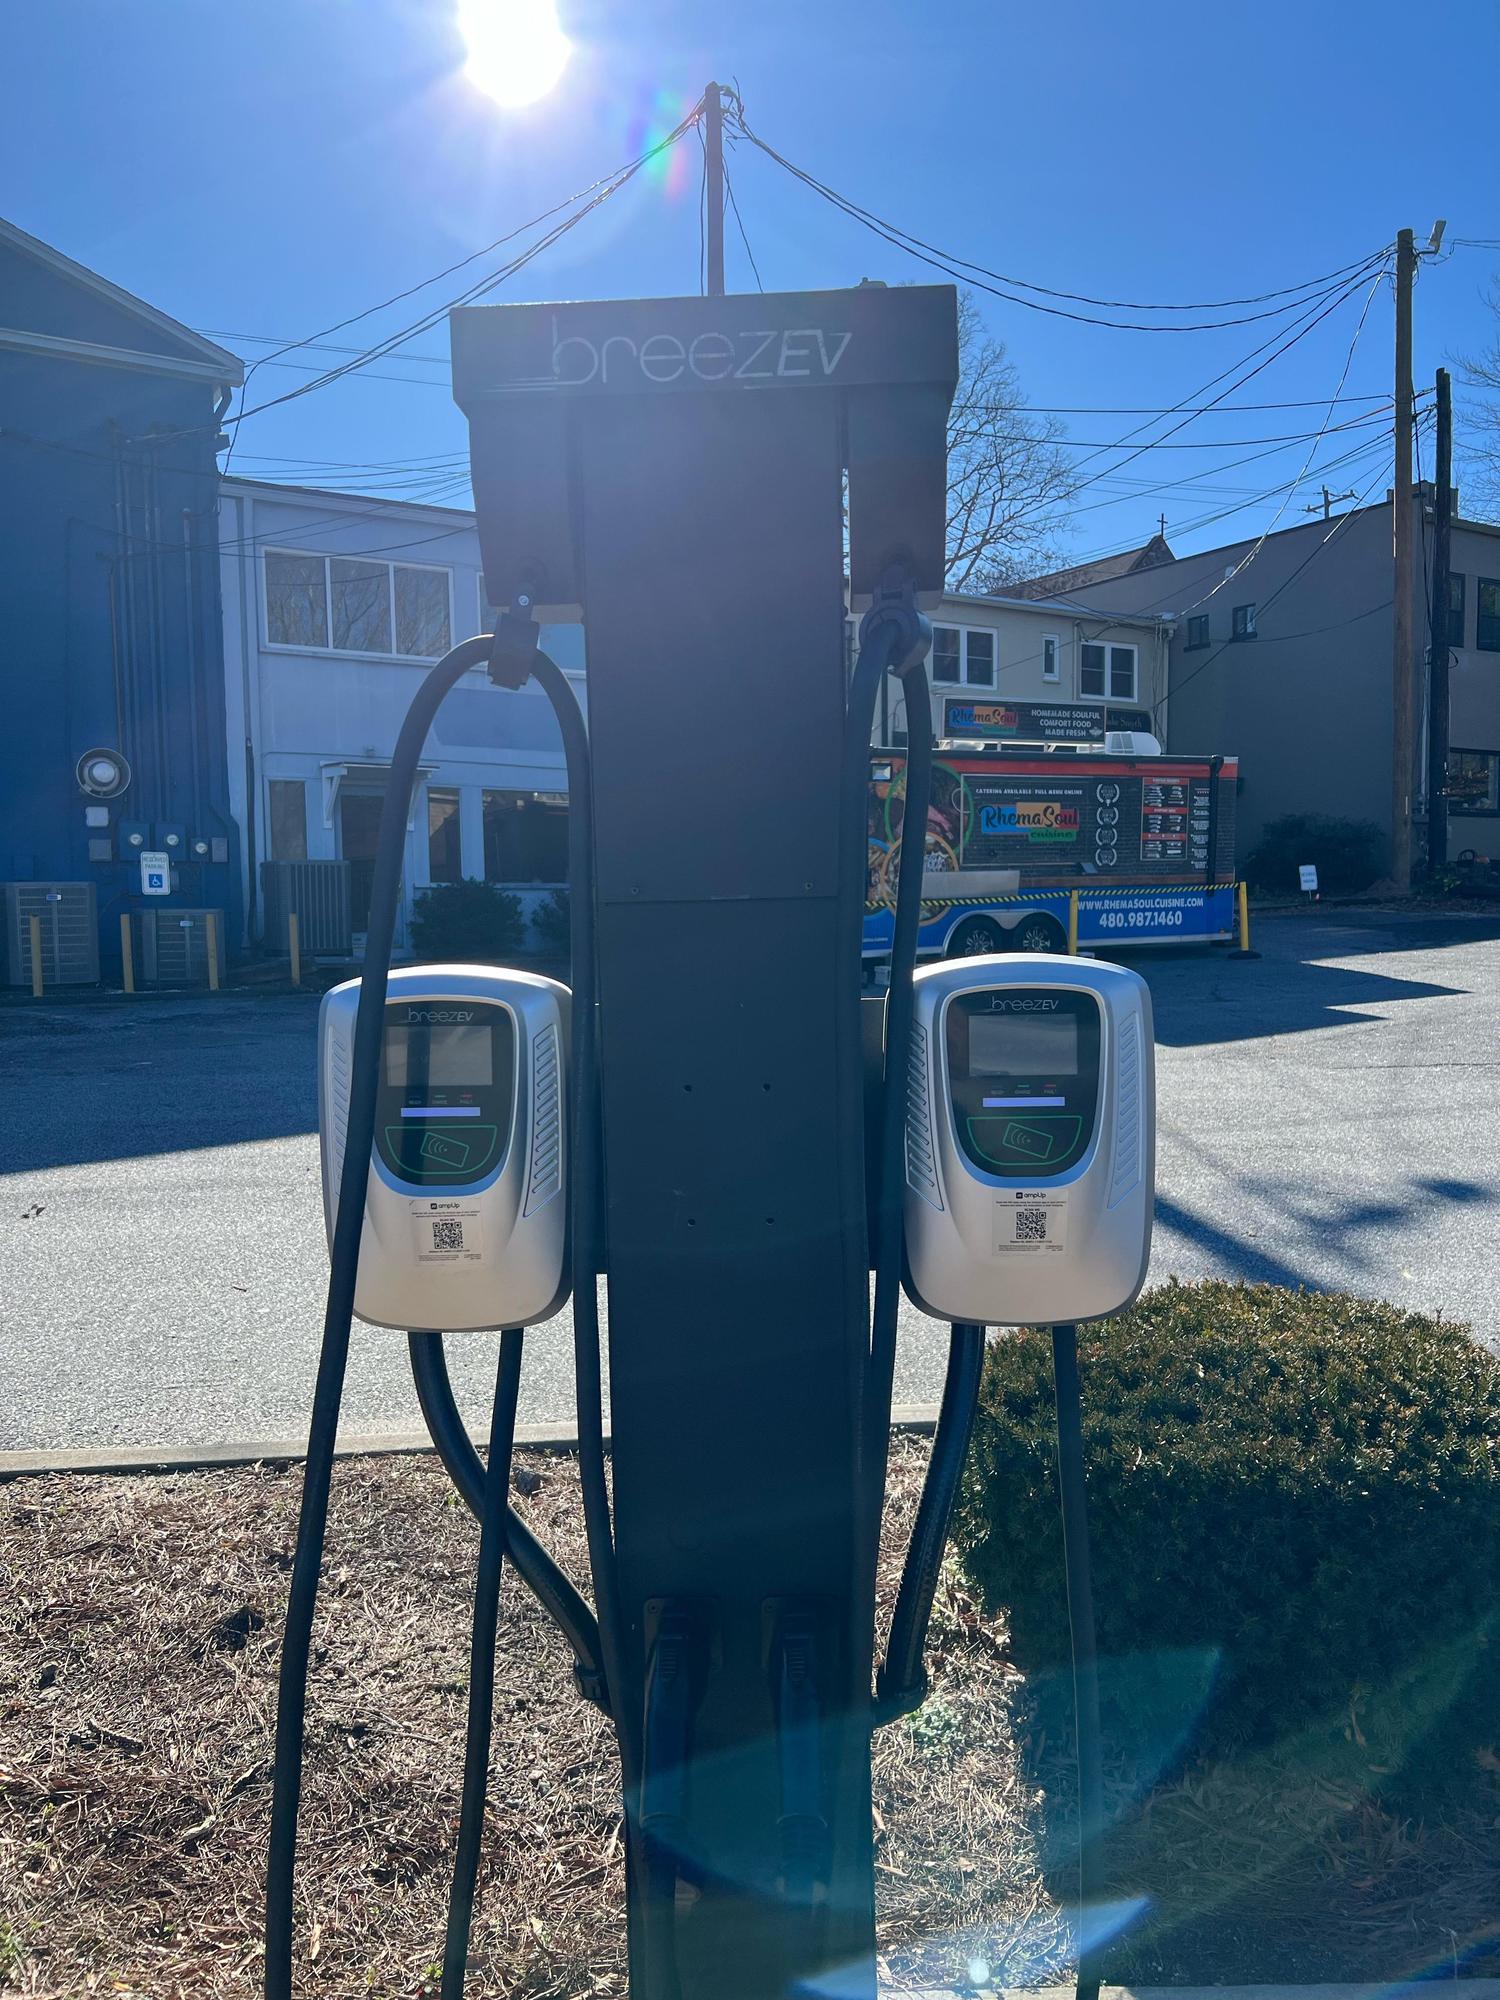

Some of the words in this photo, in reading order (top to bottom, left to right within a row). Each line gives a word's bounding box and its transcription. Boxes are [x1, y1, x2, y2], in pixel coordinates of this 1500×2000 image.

[550, 312, 852, 385] breezEV
[1031, 708, 1071, 719] HOMEMADE
[1072, 709, 1101, 719] SOULFUL
[1039, 718, 1072, 728] COMFORT
[1073, 720, 1092, 728] FOOD
[1044, 728, 1065, 736] MADE
[1066, 729, 1086, 737] FRESH
[979, 804, 1079, 828] RhemaSoul
[1077, 897, 1204, 911] WWW.RHEMASOULCUISINE.COM
[1099, 910, 1183, 928] 480.987.1460
[992, 996, 1060, 1011] breezEV
[408, 1007, 474, 1023] breezEV
